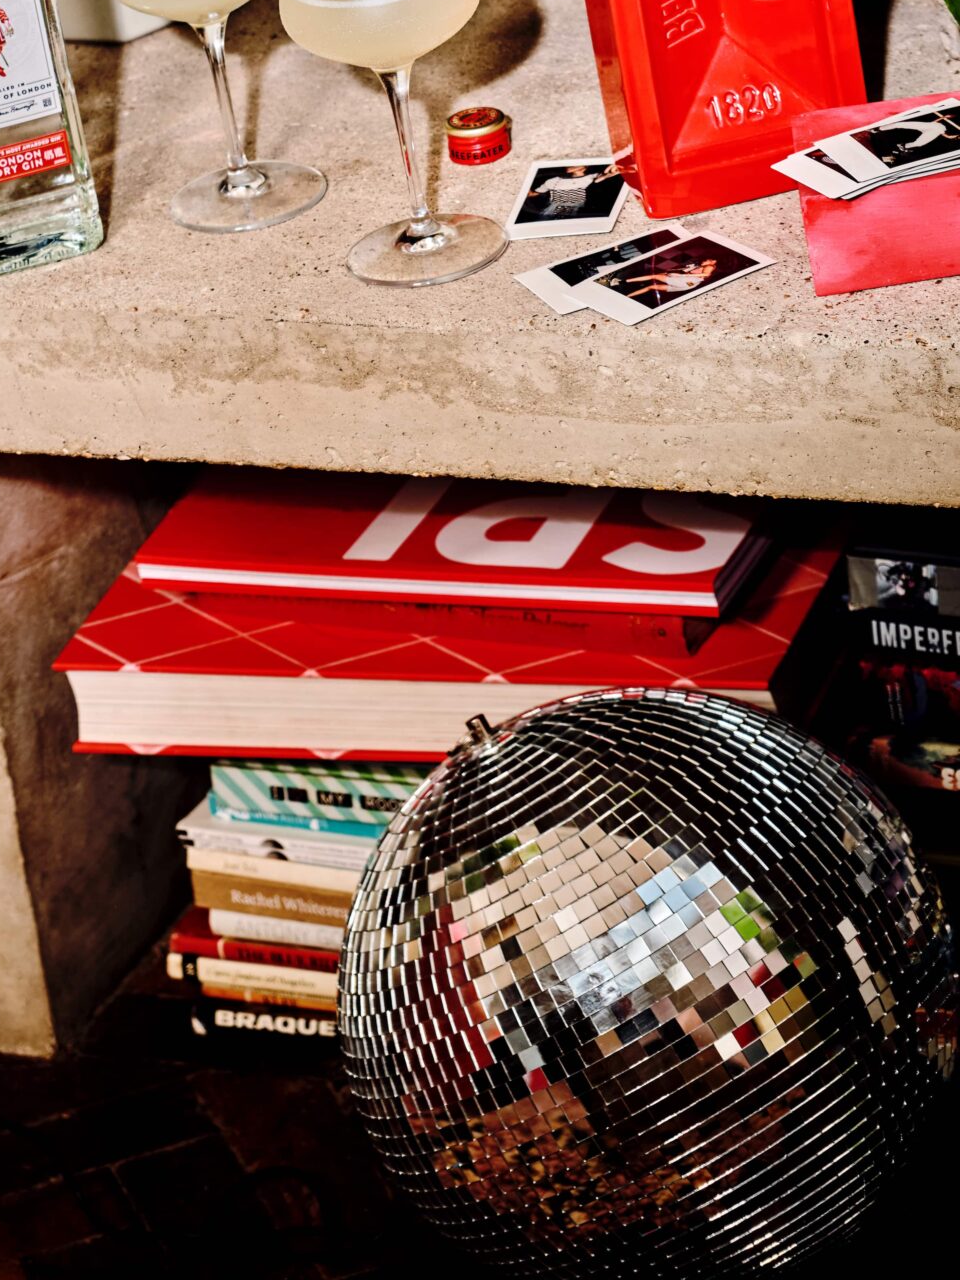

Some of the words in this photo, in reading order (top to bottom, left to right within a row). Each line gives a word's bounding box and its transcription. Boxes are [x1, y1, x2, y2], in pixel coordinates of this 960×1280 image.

[3, 92, 14, 100] OF
[17, 82, 53, 97] LONDON
[704, 81, 782, 130] 1820
[5, 147, 21, 155] MOST
[21, 139, 50, 152] AWARDED
[451, 144, 504, 161] BEEFEATER
[22, 158, 44, 171] GIN
[320, 792, 345, 806] MY
[365, 797, 406, 812] ROO
[230, 888, 281, 910] Rachel
[214, 1009, 338, 1038] BRAQUE
